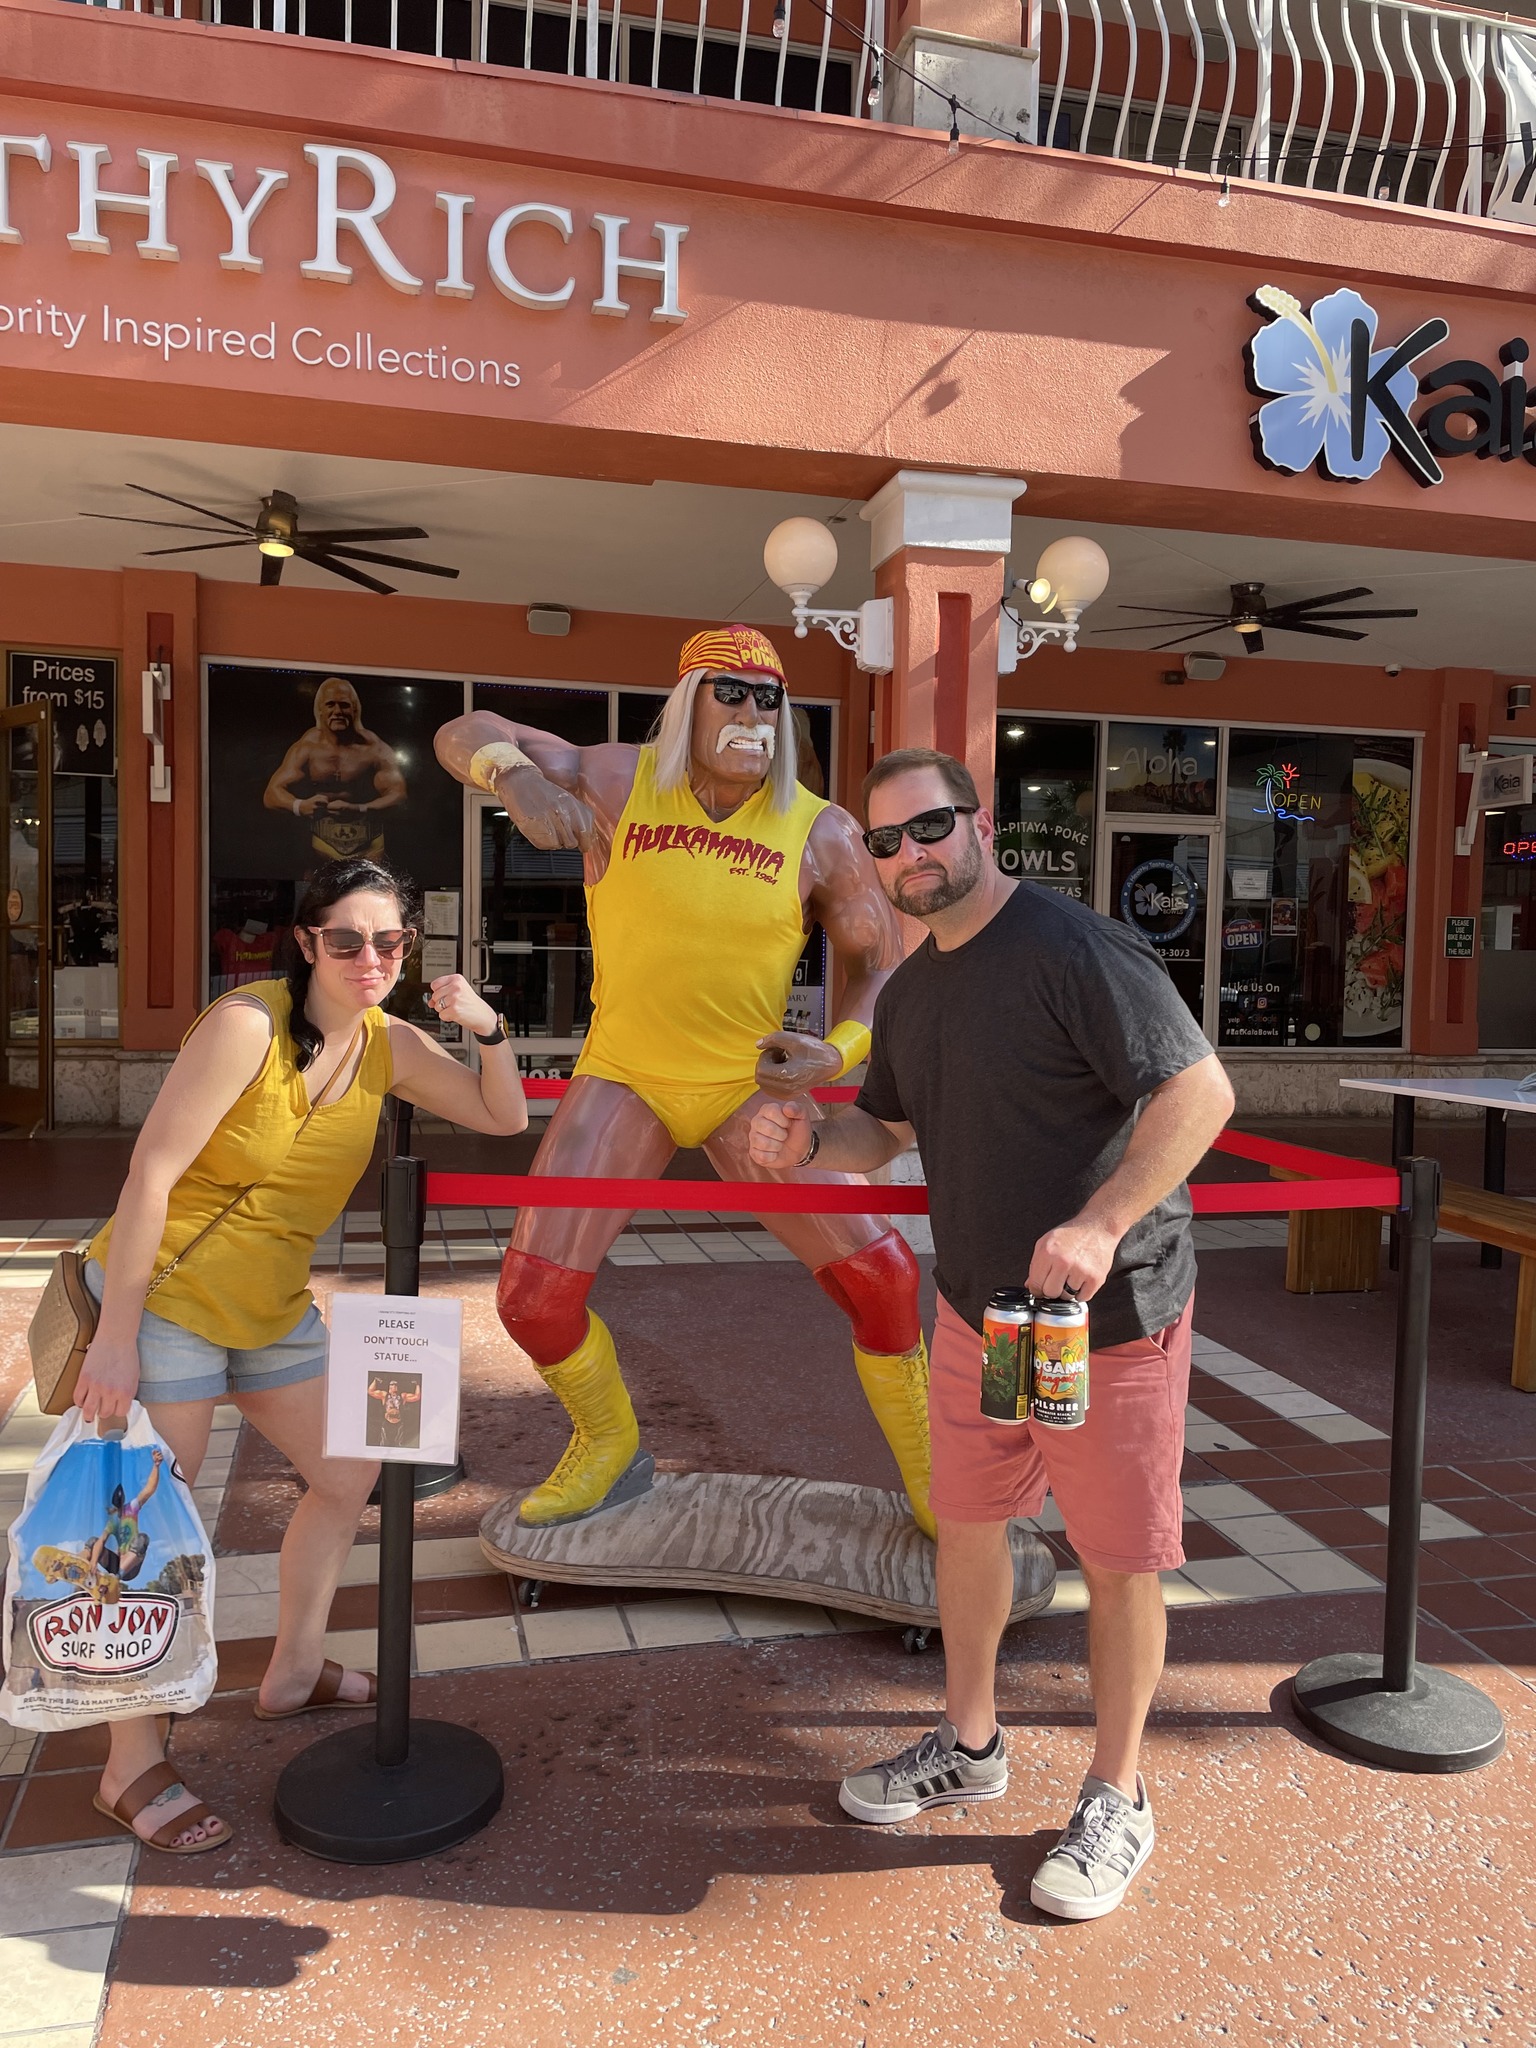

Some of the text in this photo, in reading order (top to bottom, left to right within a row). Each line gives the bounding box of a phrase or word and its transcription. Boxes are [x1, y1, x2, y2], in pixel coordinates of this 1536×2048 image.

[103, 304, 276, 362] Inspired
[291, 327, 522, 388] Collections
[1350, 317, 1536, 488] Kai
[33, 659, 95, 683] Prices
[22, 686, 105, 710] from $15
[1123, 747, 1199, 777] Aloha
[1493, 773, 1521, 793] Kaia
[1273, 792, 1322, 810] OPEN
[1008, 821, 1048, 835] PITAYA
[1054, 825, 1089, 846] POKE
[623, 822, 786, 877] HULKAMANIA
[729, 867, 778, 886] EST. 1984
[1151, 891, 1185, 912] Kaia
[1451, 919, 1470, 927] PLEASE
[1455, 926, 1465, 934] USE
[1226, 932, 1259, 947] OPEN
[1227, 981, 1280, 993] Like Us On
[378, 1319, 415, 1330] PLEASE
[363, 1335, 429, 1347] DON'T TOUCH
[374, 1352, 418, 1363] STATUE...
[44, 1604, 169, 1645] RON JON
[61, 1638, 152, 1660] SURF SHOP
[23, 1695, 47, 1704] REUSE
[91, 1698, 113, 1706] MANY
[115, 1695, 138, 1703] TIMES
[149, 1692, 166, 1700] YOU
[167, 1688, 187, 1697] CAN!
